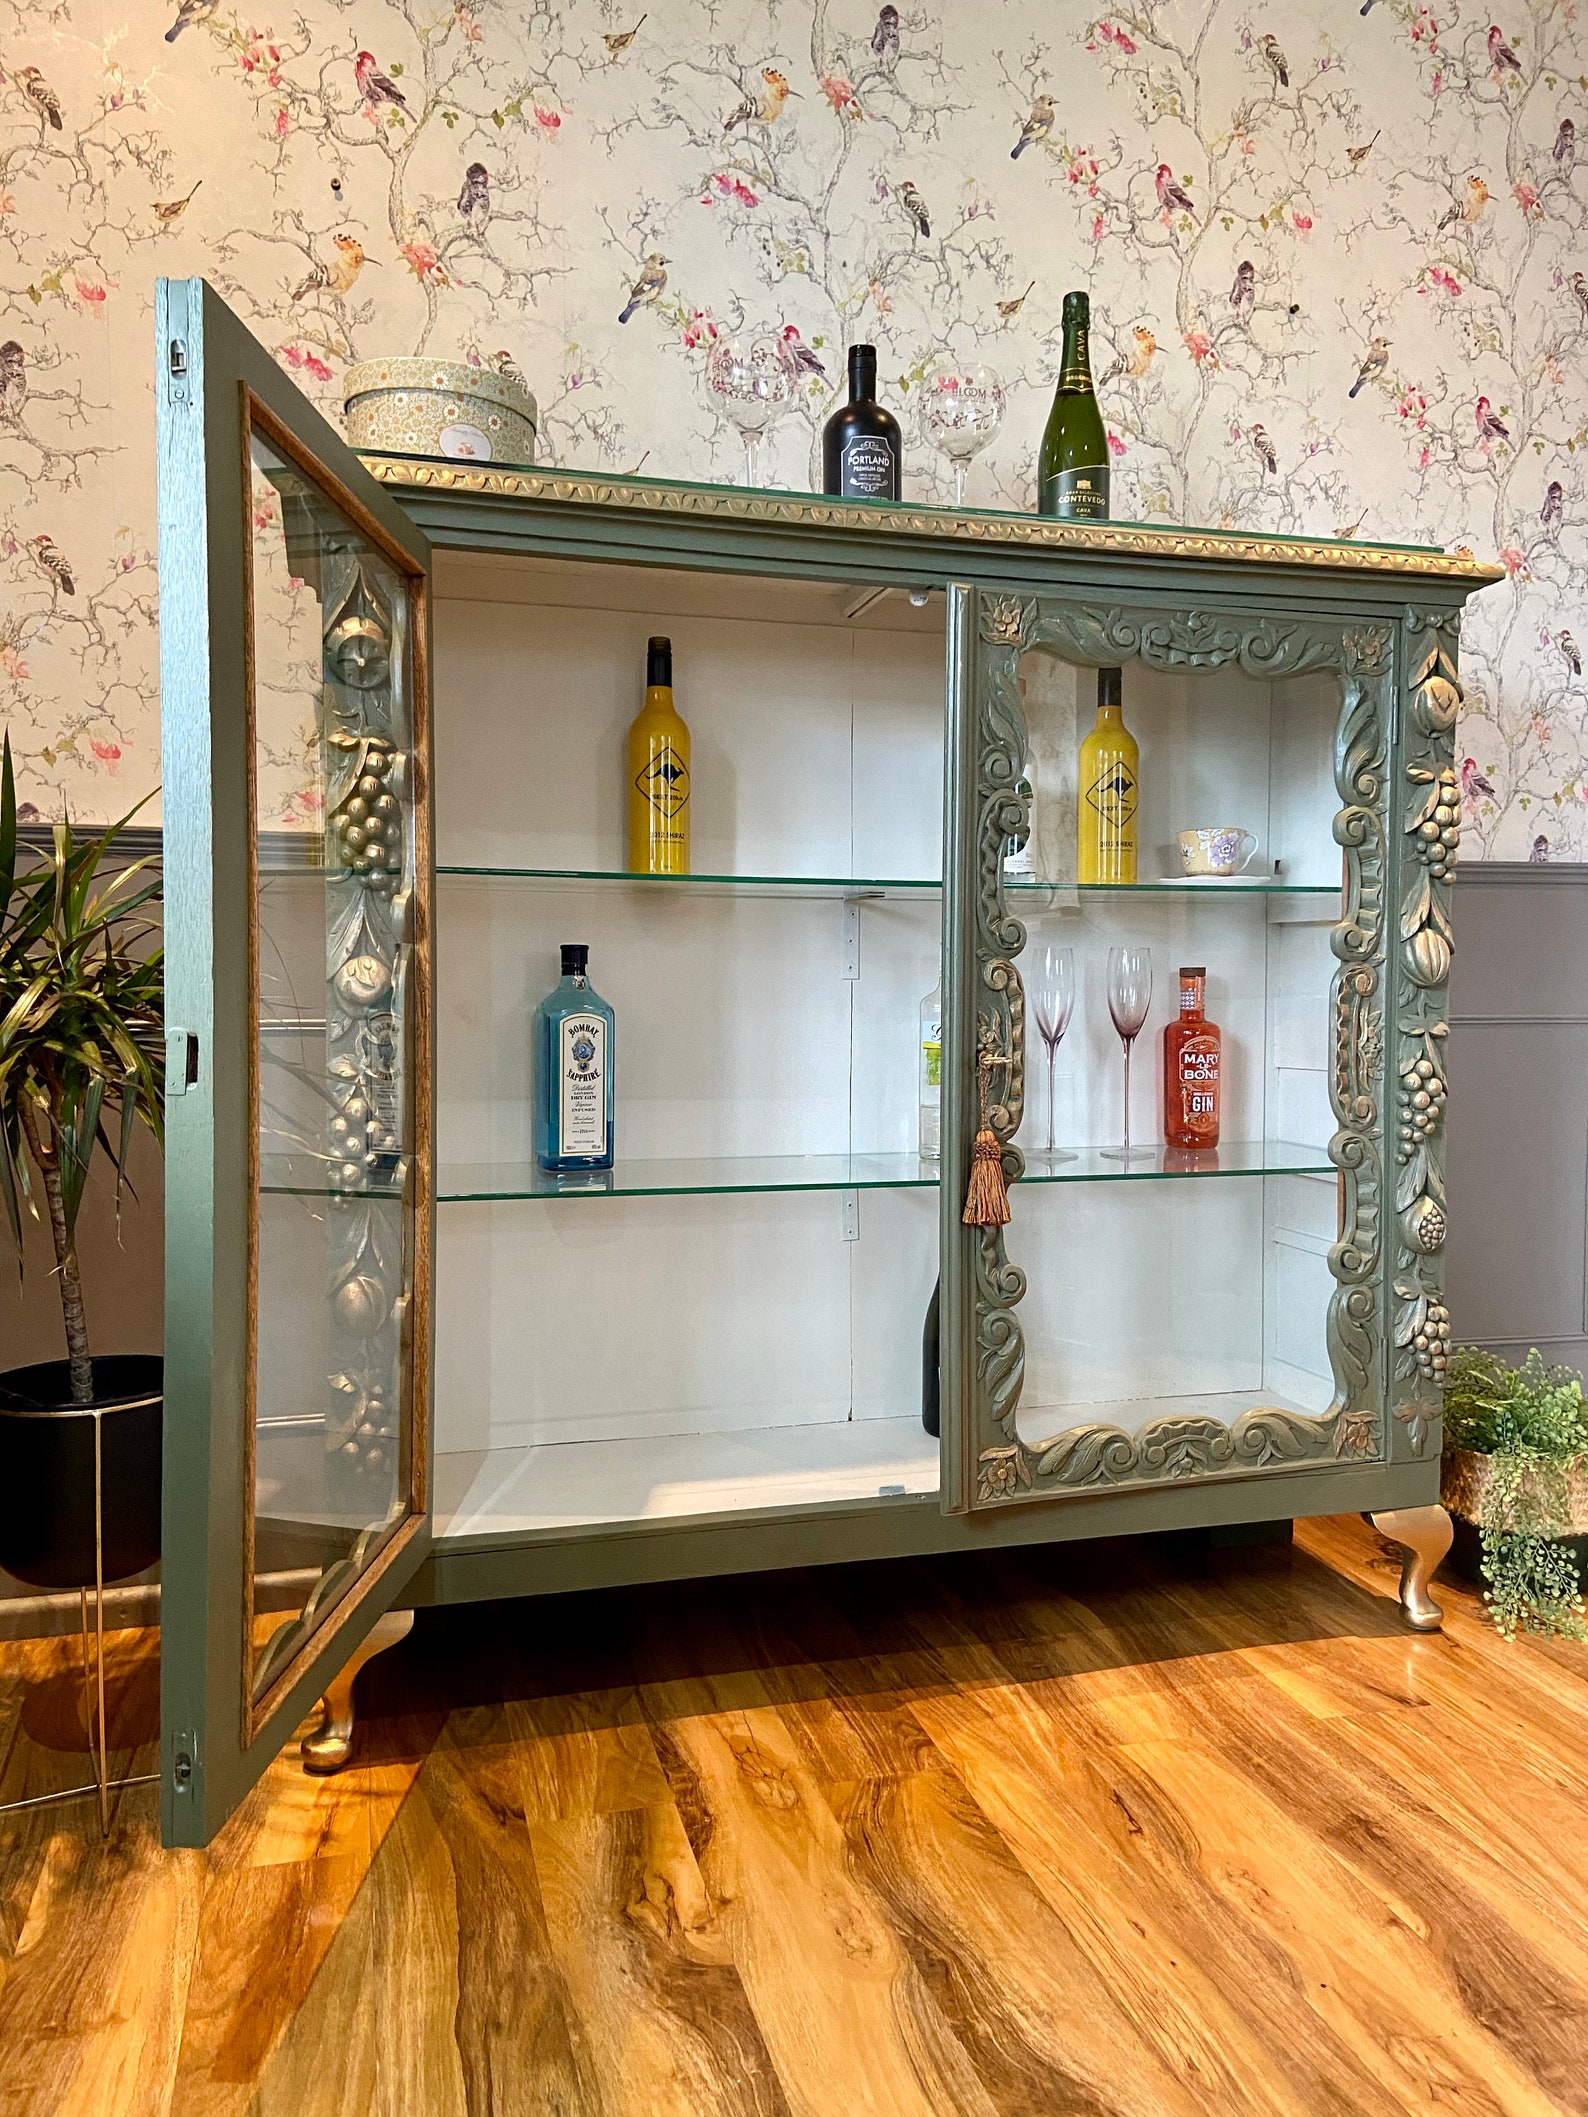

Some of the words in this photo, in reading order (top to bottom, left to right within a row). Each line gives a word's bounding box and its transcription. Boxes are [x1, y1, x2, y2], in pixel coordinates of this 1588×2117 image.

[1077, 329, 1085, 361] CAVA
[848, 455, 889, 467] PORTLAND
[1058, 495, 1106, 506] CONTEVEDO
[568, 1023, 600, 1038] BOMBAY
[1184, 1053, 1219, 1065] MARY
[566, 1067, 601, 1082] SAPPHIRE
[1184, 1069, 1219, 1080] BONE
[1192, 1096, 1213, 1112] GIN
